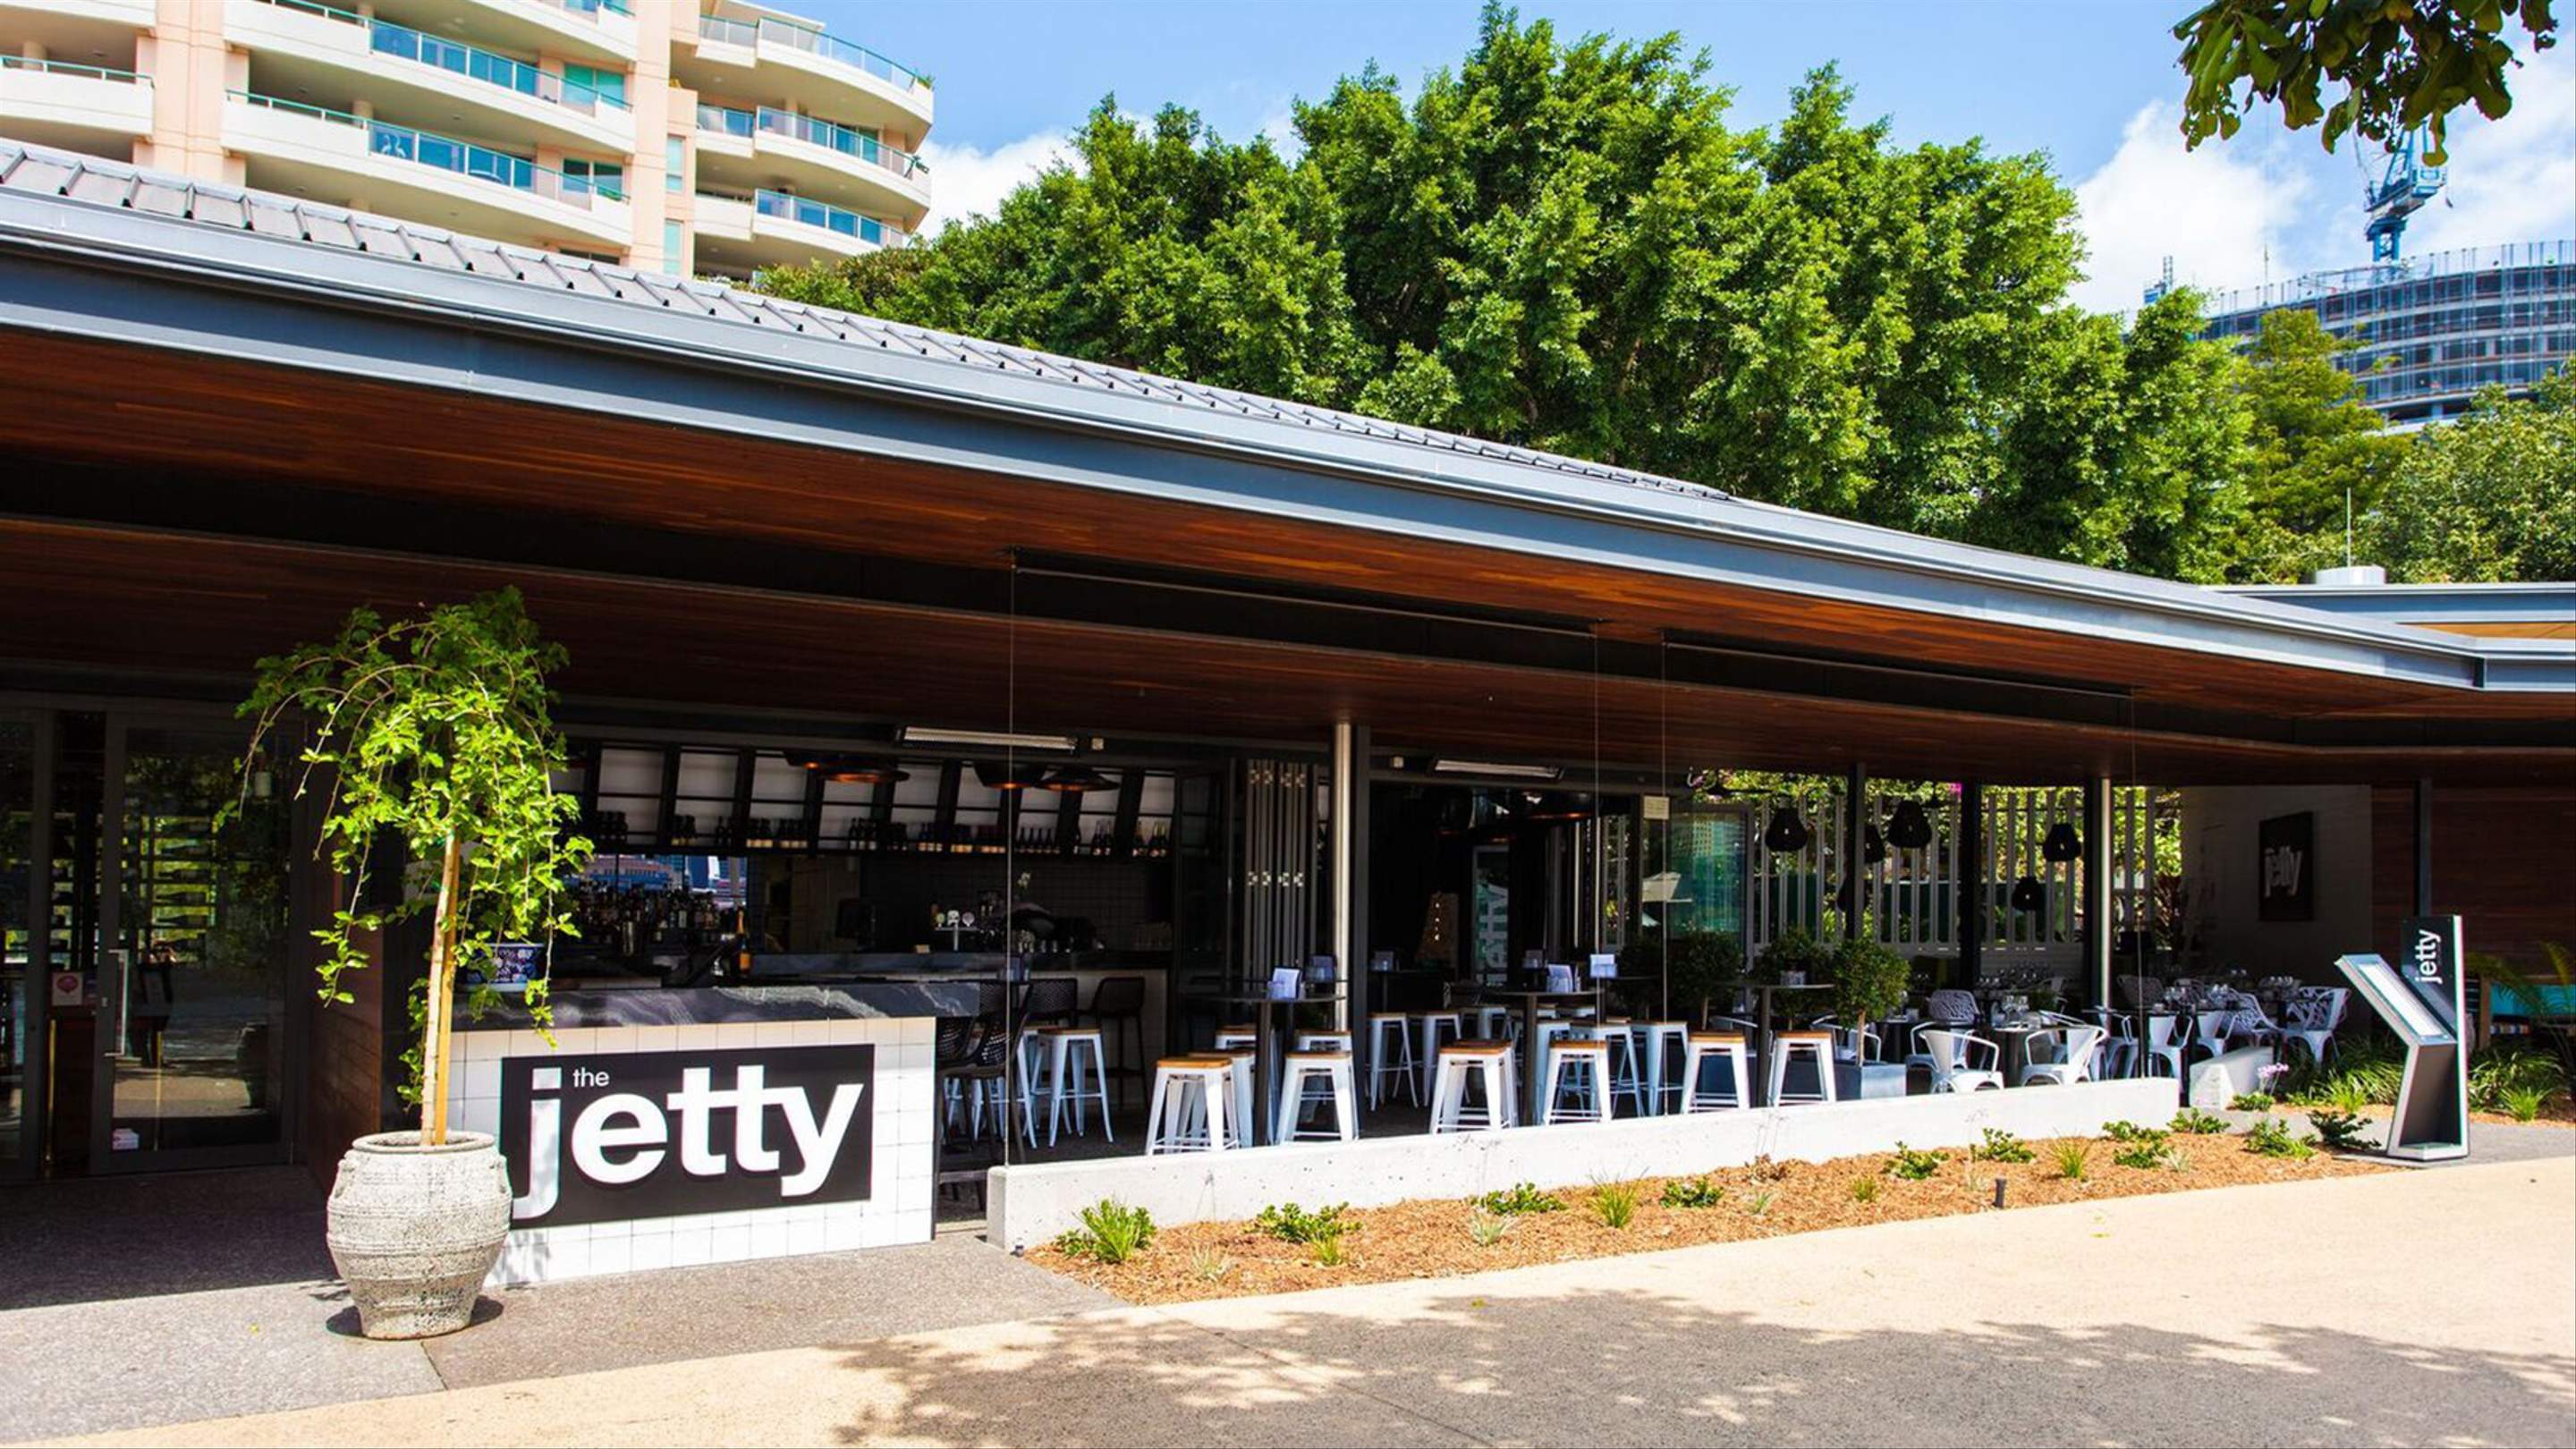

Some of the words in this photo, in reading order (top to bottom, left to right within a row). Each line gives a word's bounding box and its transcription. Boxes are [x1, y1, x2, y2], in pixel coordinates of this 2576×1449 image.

[2264, 845, 2303, 897] jetty
[2414, 928, 2443, 985] jetty
[572, 1066, 610, 1089] the
[512, 1064, 864, 1220] jetty
